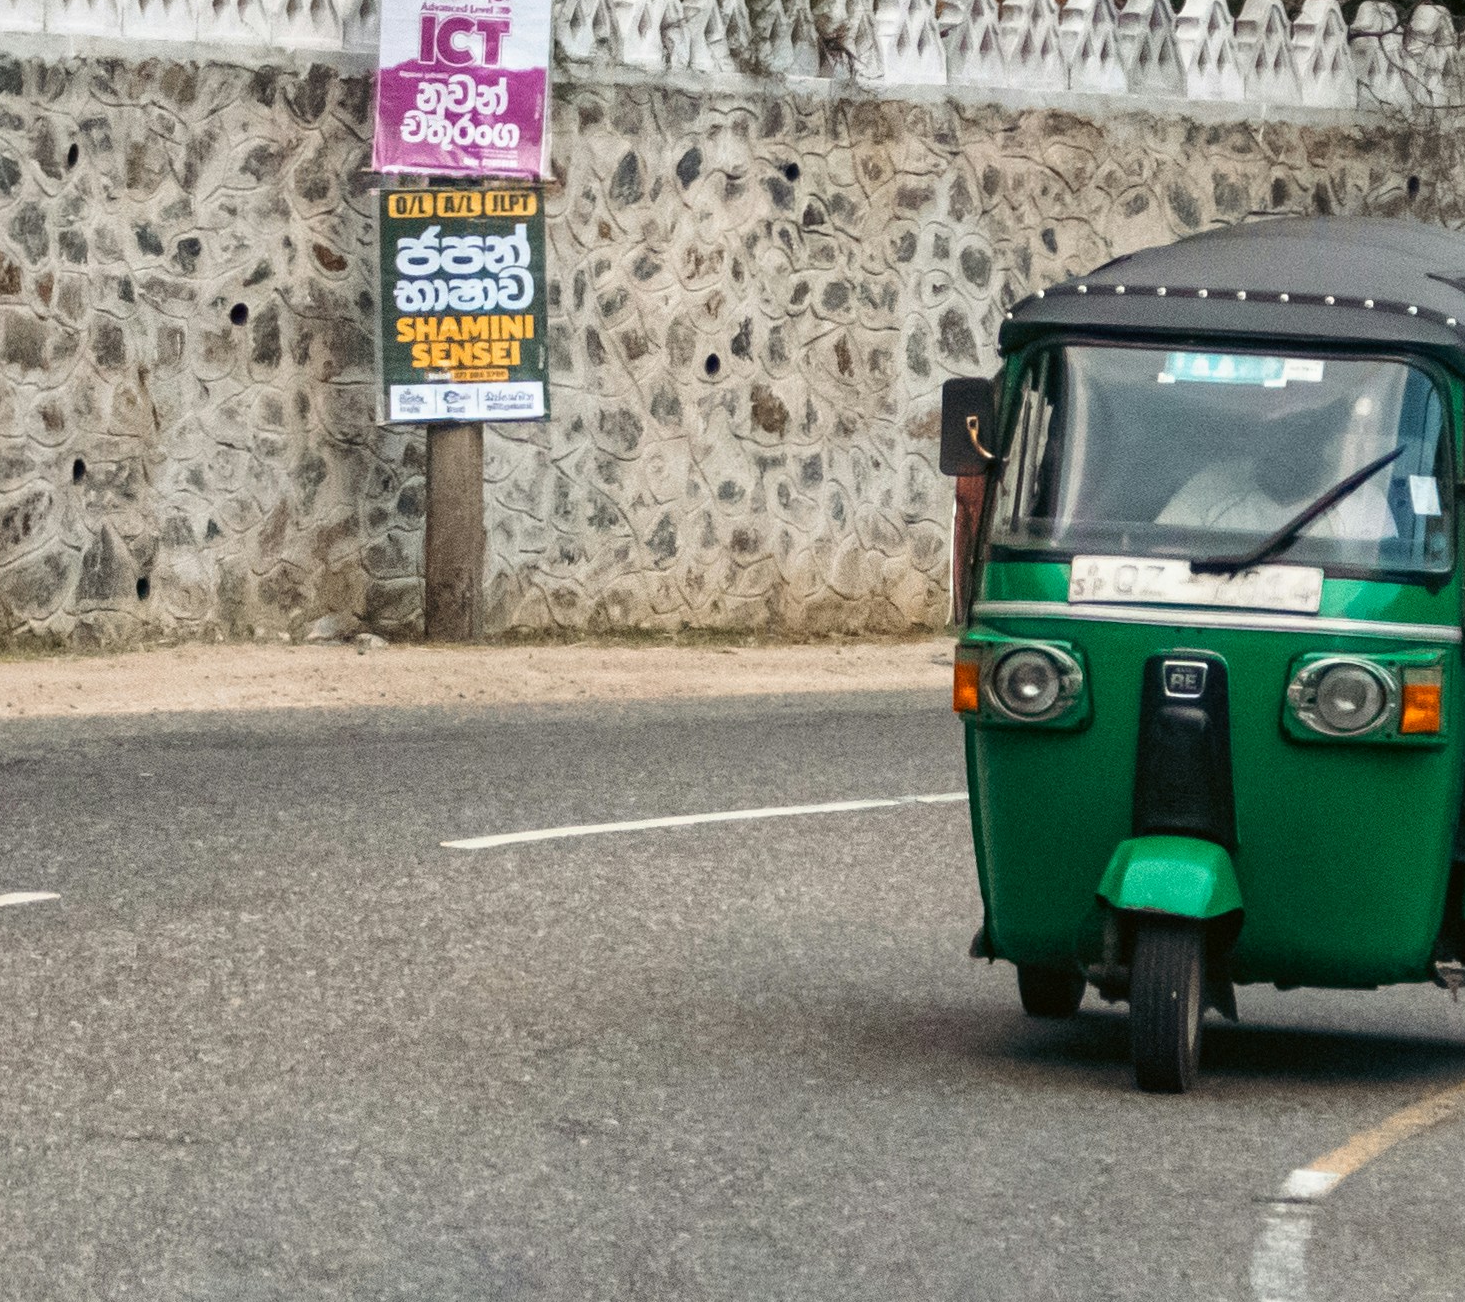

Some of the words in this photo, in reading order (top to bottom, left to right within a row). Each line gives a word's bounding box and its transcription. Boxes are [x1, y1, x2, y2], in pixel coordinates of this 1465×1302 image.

[421, 2, 468, 14] Advanced
[470, 5, 494, 15] Level
[419, 13, 511, 67] ICT
[416, 73, 509, 120] නුවන්
[400, 109, 521, 151] චතුරංග
[395, 196, 426, 215] O/L
[443, 195, 475, 213] A/L
[492, 193, 529, 212] JLPT
[395, 222, 531, 276] ජපන්
[393, 266, 534, 312] භාෂාව
[395, 314, 534, 343] SHAMINI
[411, 340, 521, 368] SENSEI
